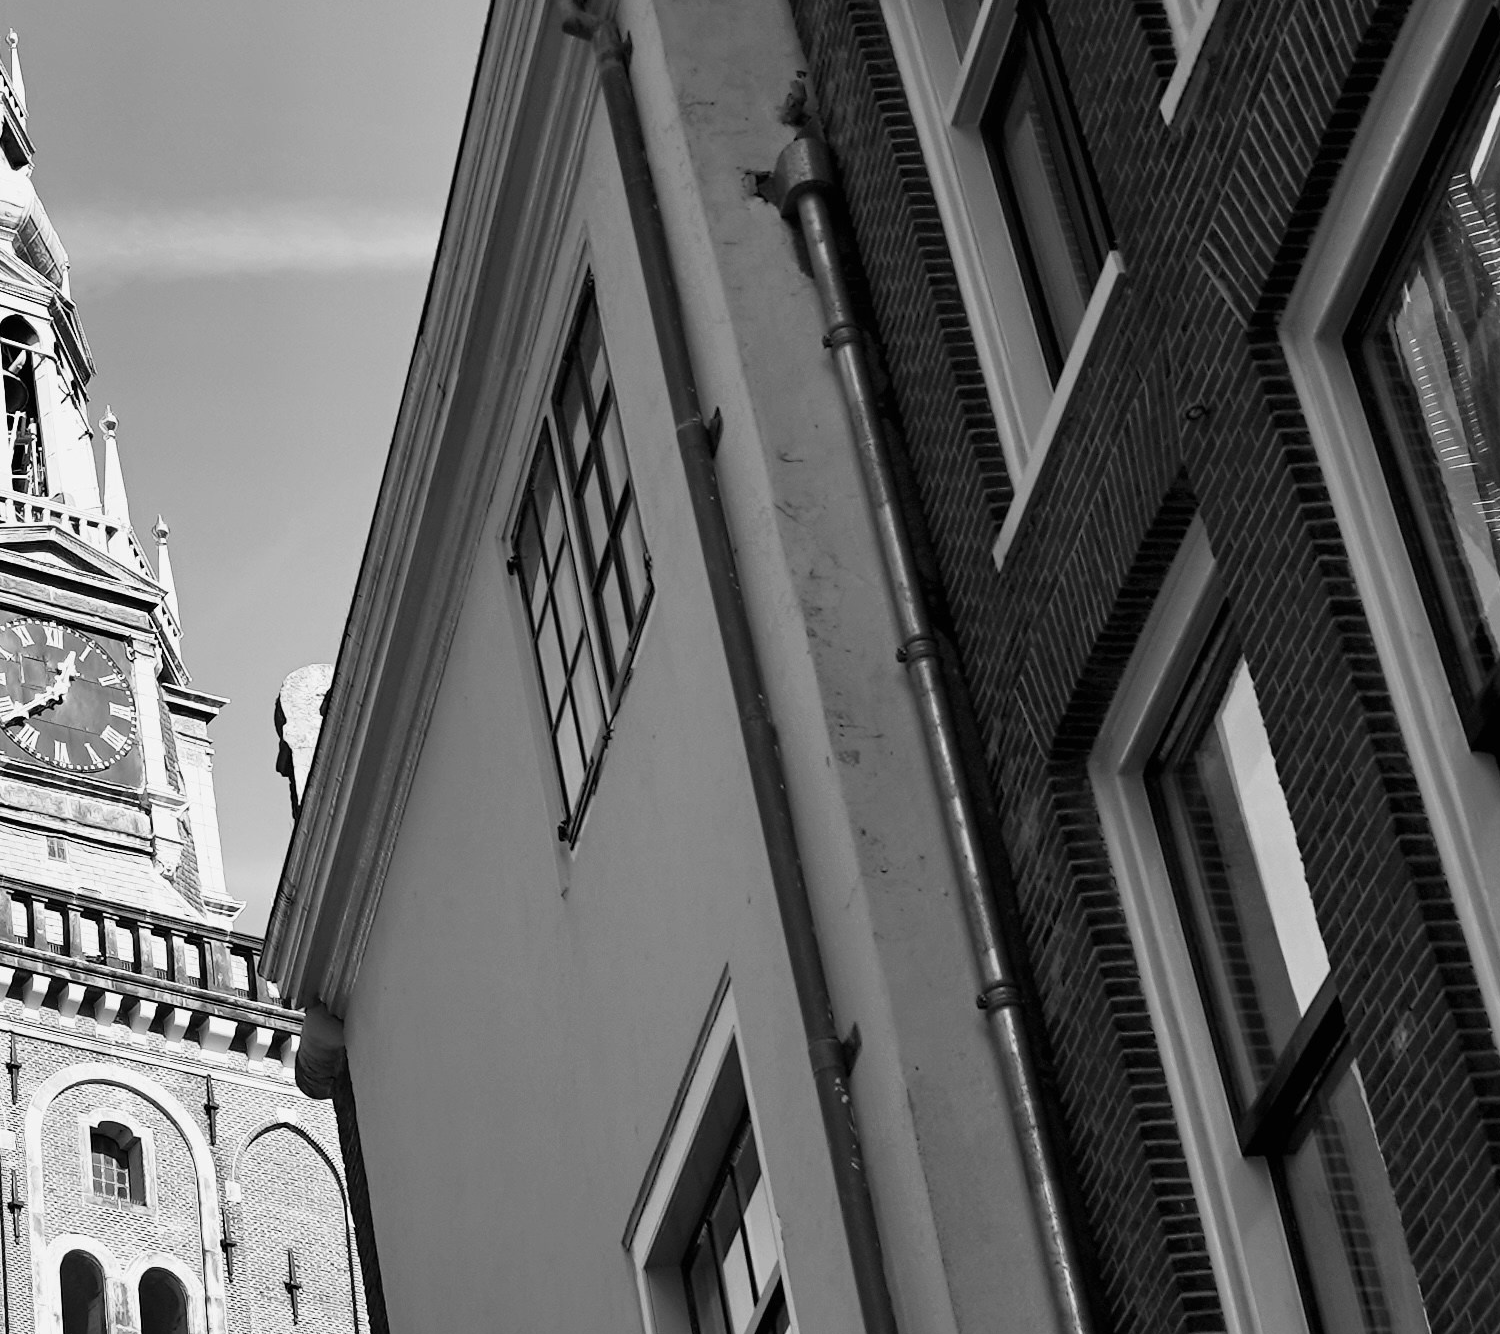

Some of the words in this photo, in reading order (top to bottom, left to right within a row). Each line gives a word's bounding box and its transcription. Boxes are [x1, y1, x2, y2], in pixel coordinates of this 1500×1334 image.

[11, 625, 35, 648] XI
[42, 625, 64, 650] XII
[78, 644, 94, 662] I
[97, 673, 122, 687] II
[108, 702, 133, 722] III
[17, 723, 41, 750] VII
[100, 725, 128, 751] IIII
[54, 739, 70, 765] VI
[84, 742, 104, 765] V
